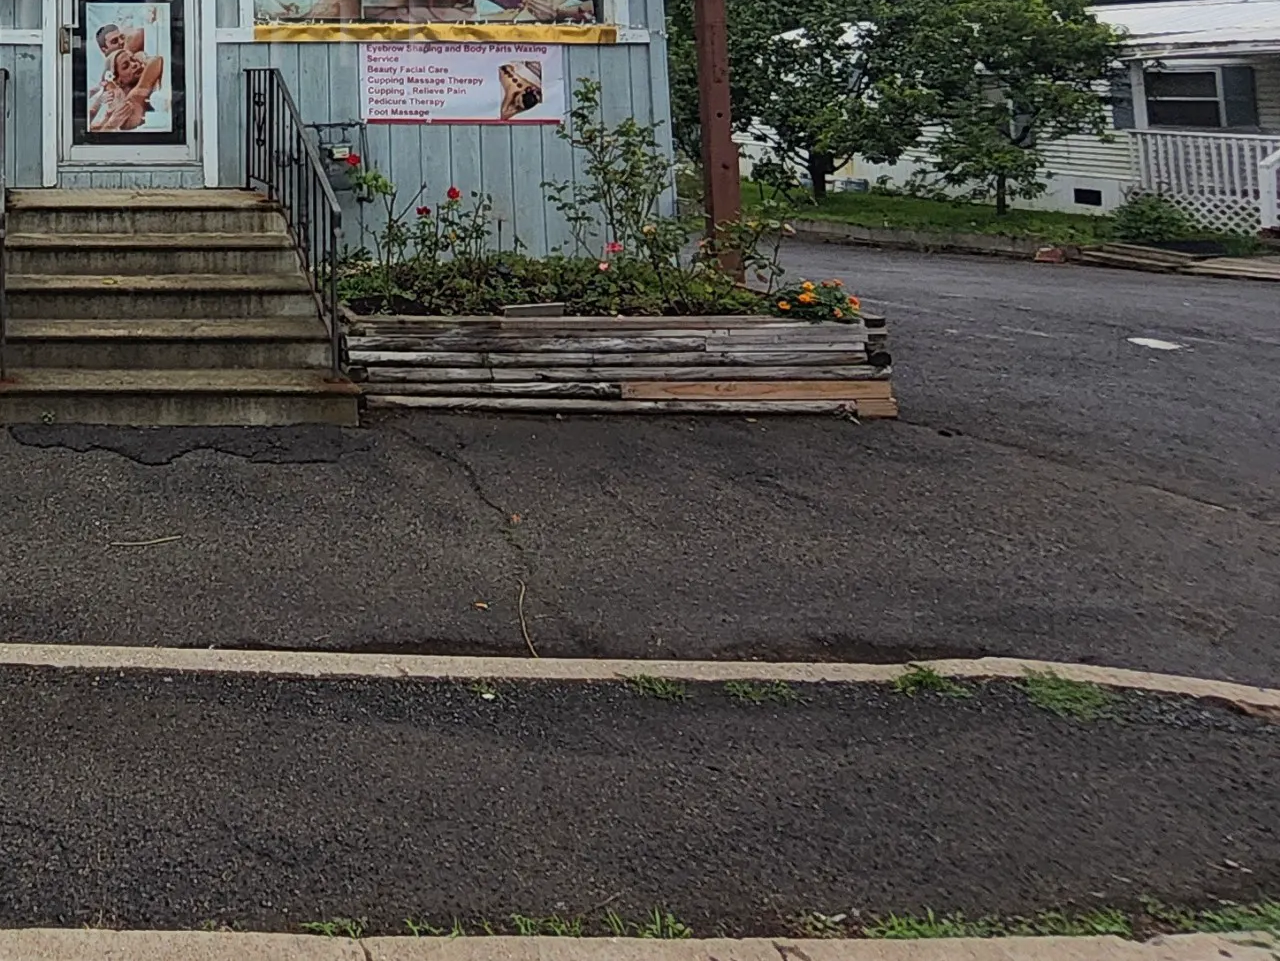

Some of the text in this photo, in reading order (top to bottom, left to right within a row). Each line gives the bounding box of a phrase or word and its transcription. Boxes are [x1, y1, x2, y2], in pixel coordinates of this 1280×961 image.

[366, 44, 548, 55] Eyebrow Shaping and Body Parts Waxing
[367, 54, 400, 63] Service
[367, 65, 449, 75] Beauty Facial Care
[367, 76, 484, 86] Cupping Massage Therapy
[368, 86, 467, 96] Cupping Relieve Pain
[368, 97, 445, 108] Pedicure Therapy
[368, 108, 430, 118] Foot Massage
